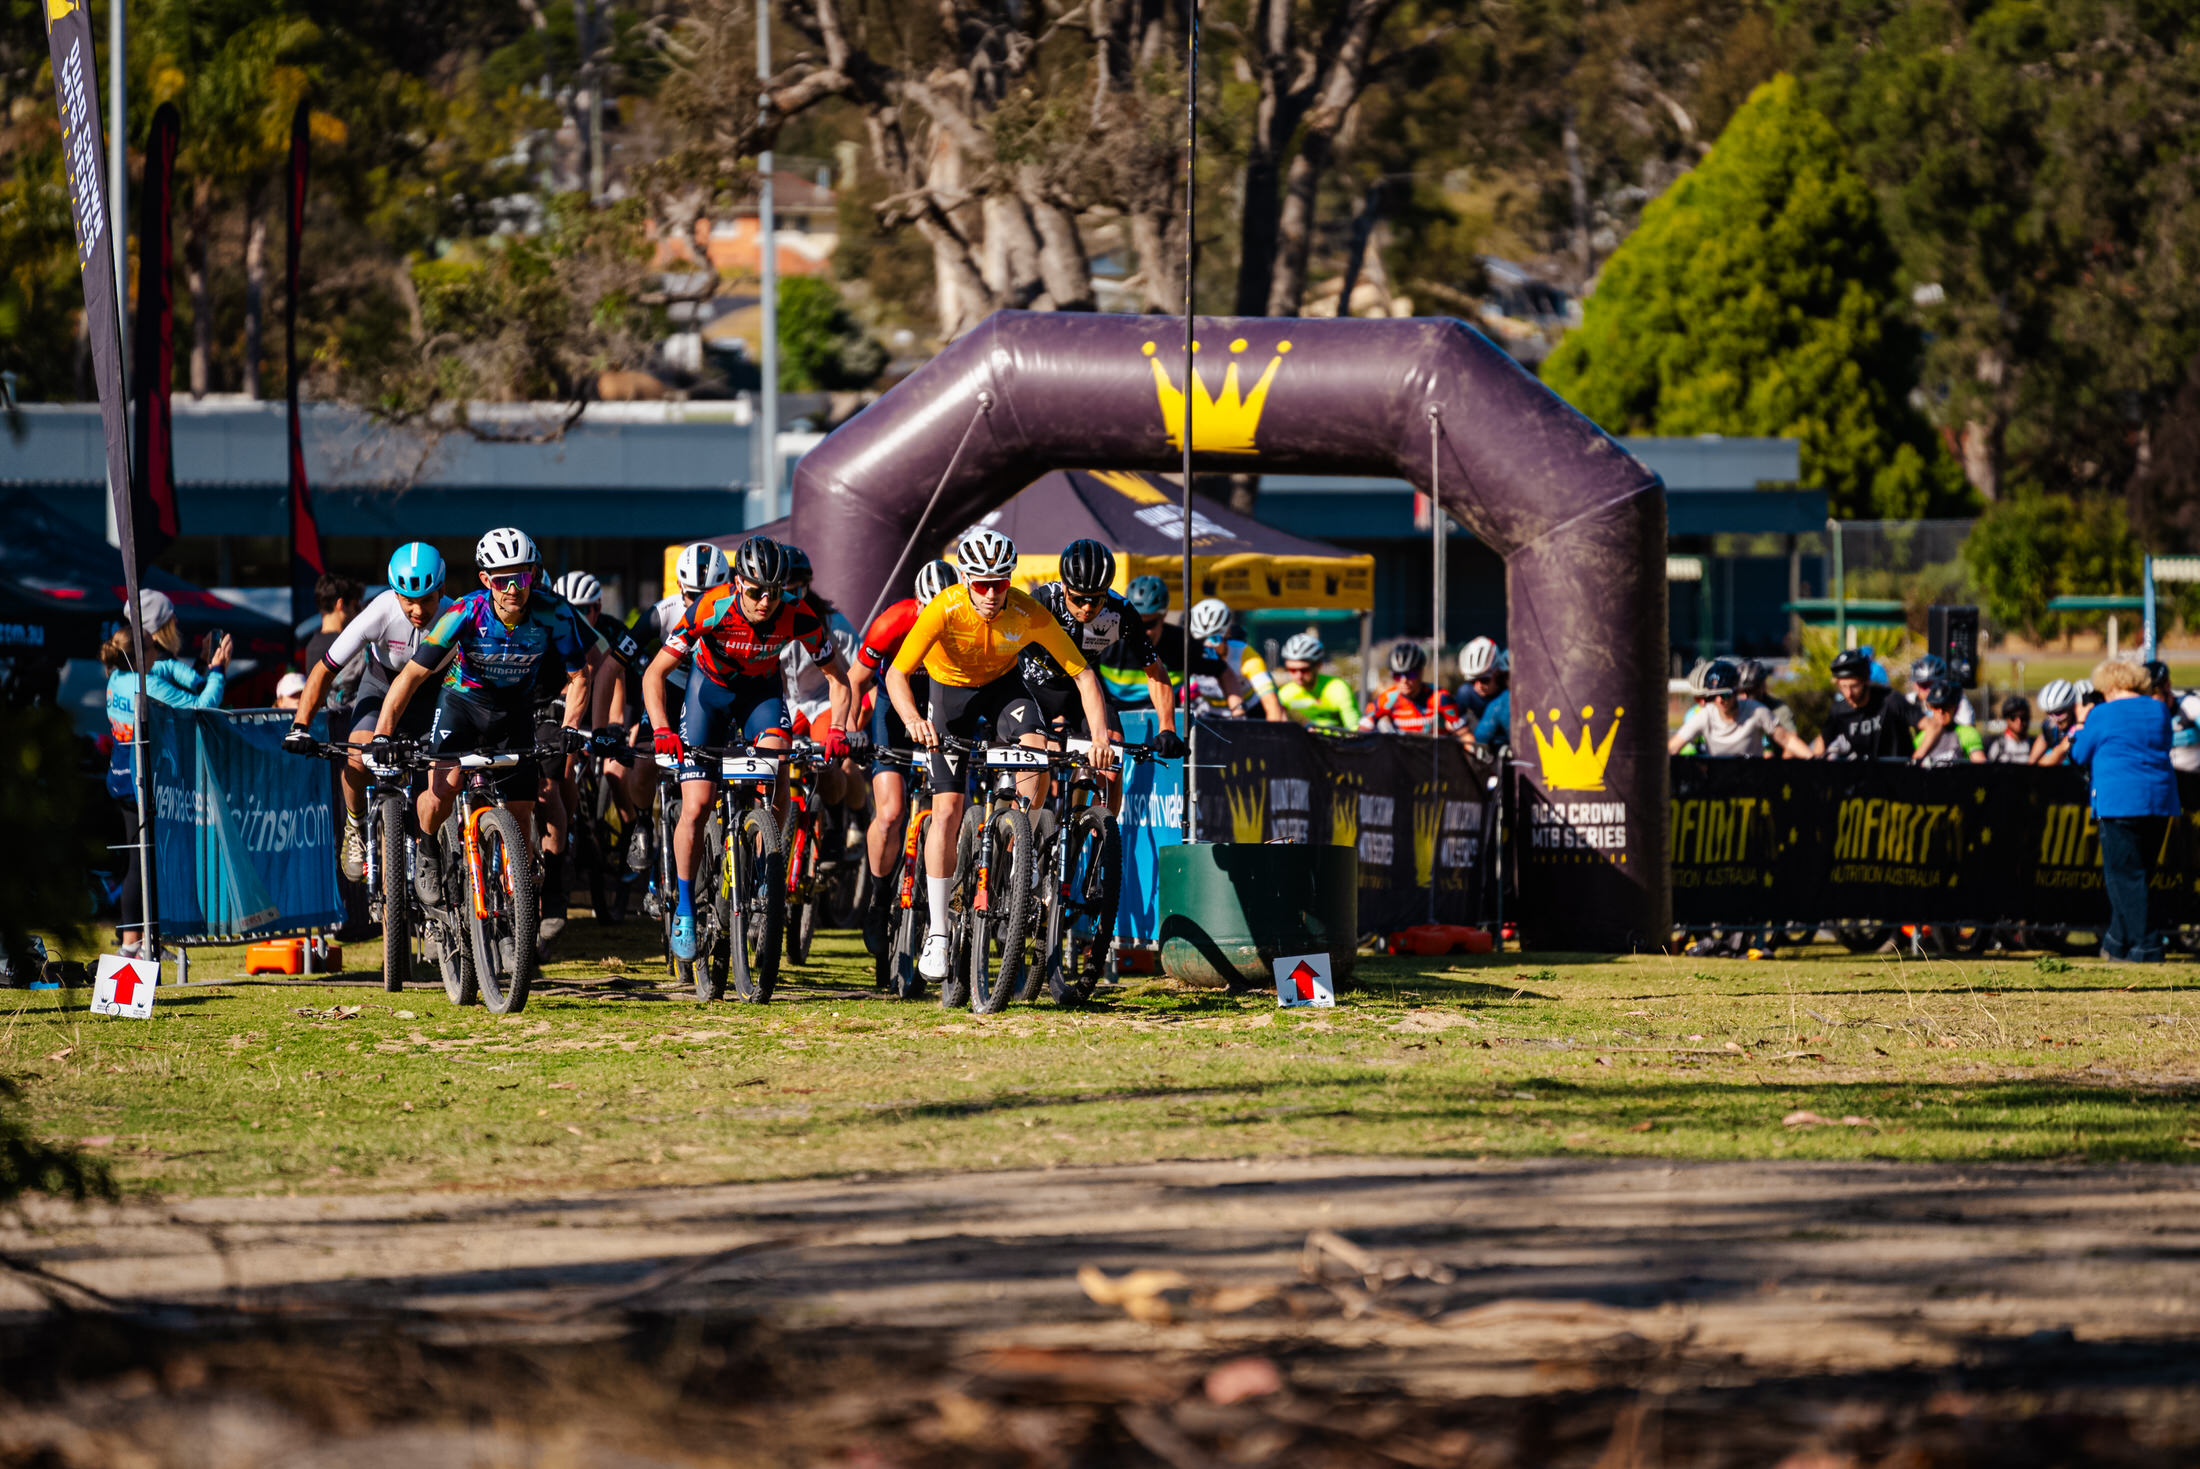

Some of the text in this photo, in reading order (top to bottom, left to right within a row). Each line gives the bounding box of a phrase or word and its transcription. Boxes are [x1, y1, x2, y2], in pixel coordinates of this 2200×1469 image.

[69, 36, 104, 239] QUAD CROWN
[62, 56, 96, 259] MTB SERIES
[472, 662, 531, 675] SHIMANO
[1849, 715, 1882, 736] FOX
[746, 760, 757, 772] 5
[999, 751, 1036, 763] 119
[1568, 802, 1626, 825] CROWN
[1531, 826, 1626, 849] MTB SERIES
